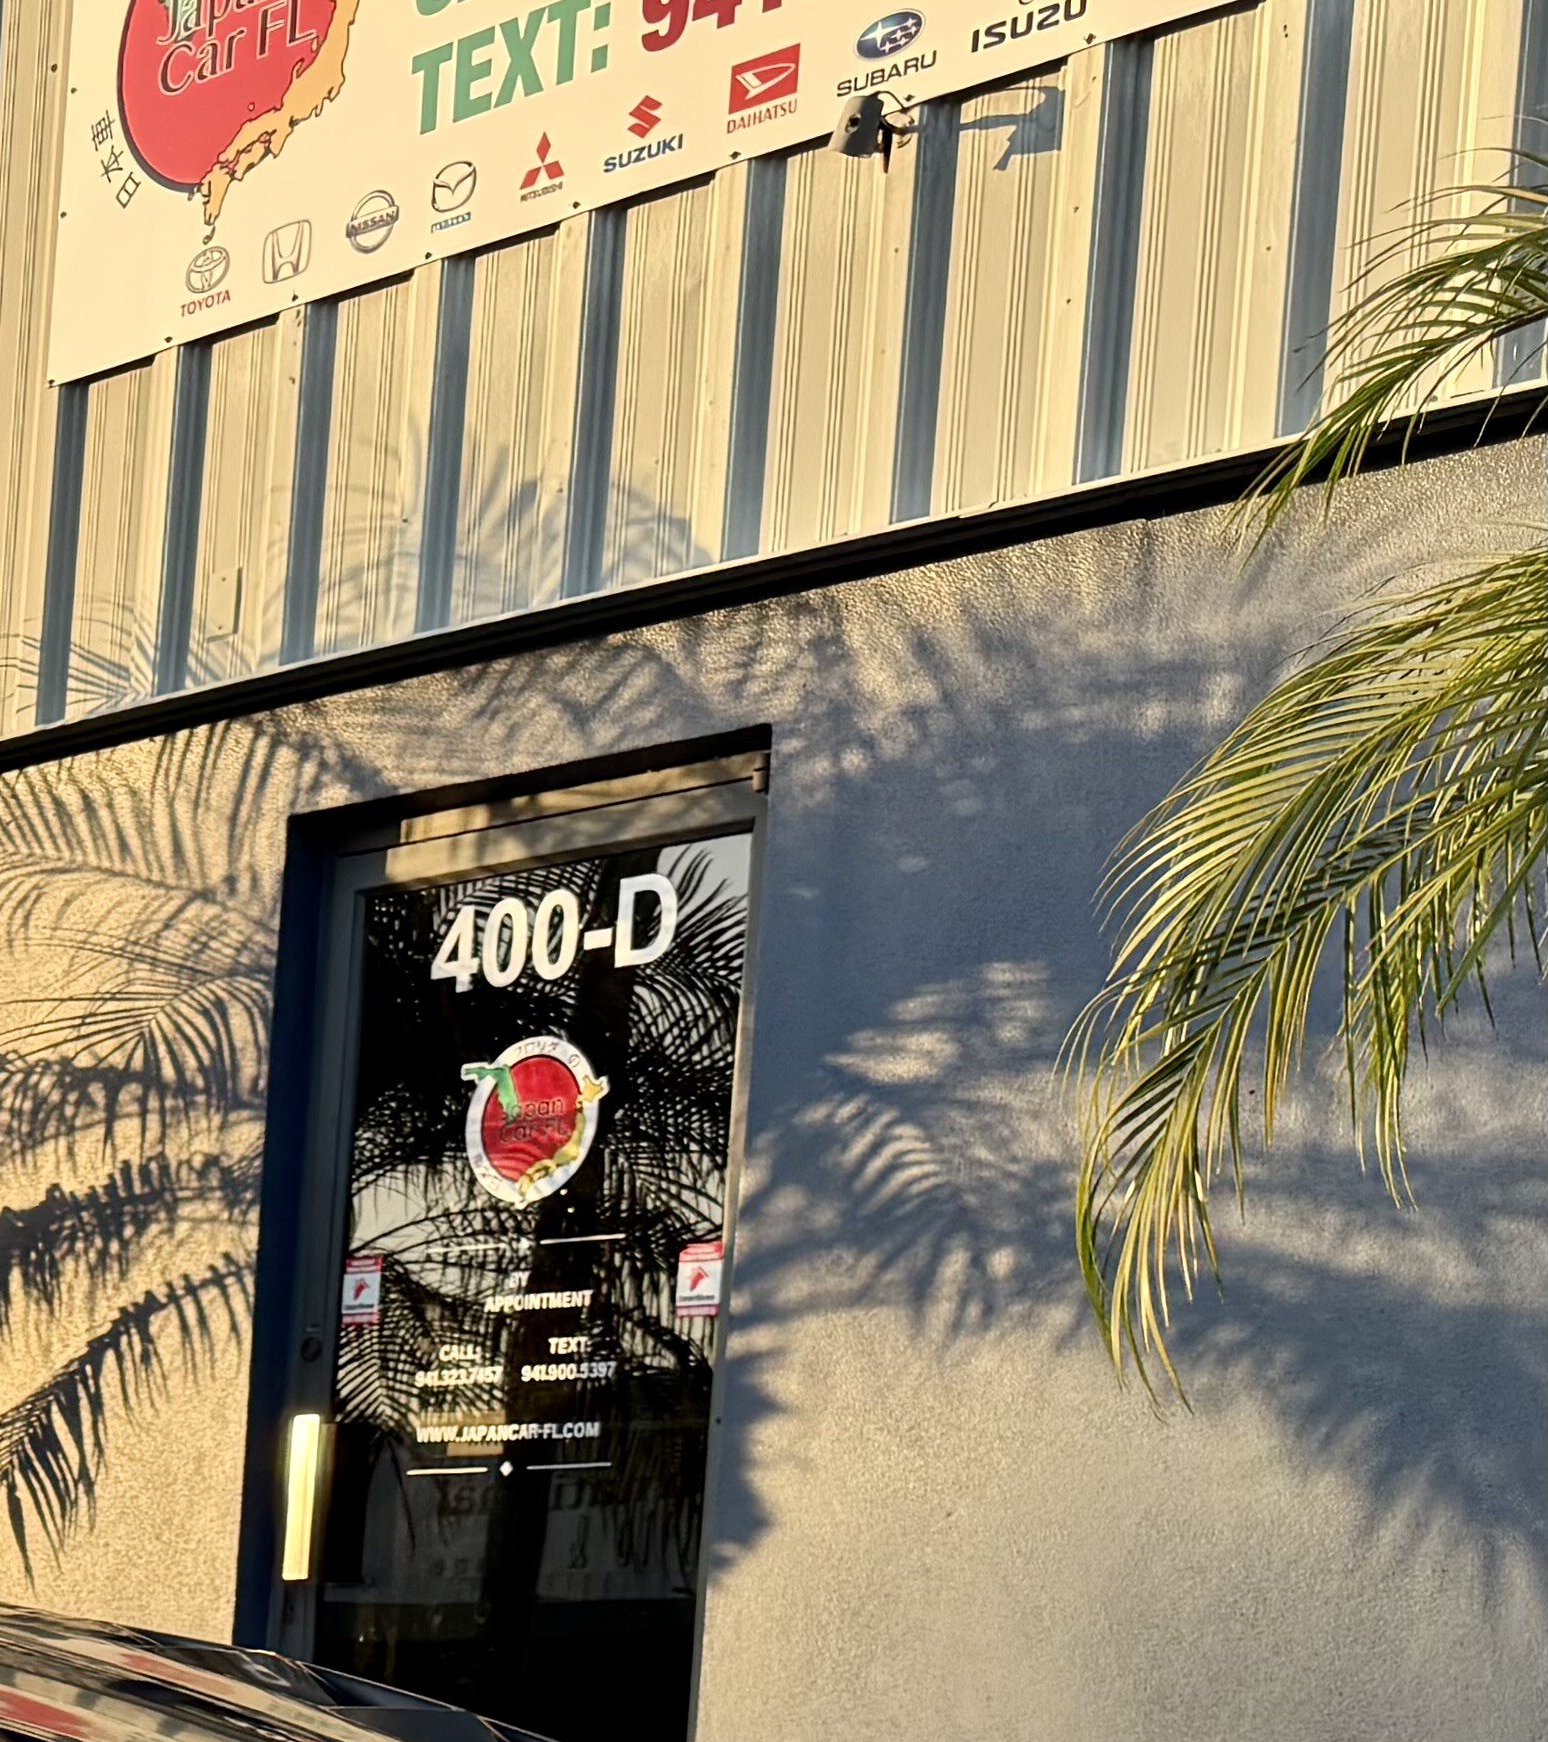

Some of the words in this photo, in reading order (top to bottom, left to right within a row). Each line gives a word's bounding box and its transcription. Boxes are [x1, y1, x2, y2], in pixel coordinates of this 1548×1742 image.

[970, 0, 1087, 53] ISUZU
[159, 27, 247, 95] Car
[257, 0, 317, 60] FL
[411, 0, 611, 135] TEXT:
[836, 50, 937, 97] SUBARU
[726, 98, 797, 134] DAIHATSU
[603, 133, 683, 173] SUZUKI
[180, 290, 231, 317] TOYOTA
[430, 873, 678, 993] 400-D
[484, 1289, 593, 1313] APPOINTMENT
[439, 1344, 483, 1362] CALL:
[547, 1336, 593, 1355] TEXT:
[521, 1361, 617, 1382] 941.900.5397
[416, 1421, 602, 1443] WWW.JAPANCAR-FL.COM
